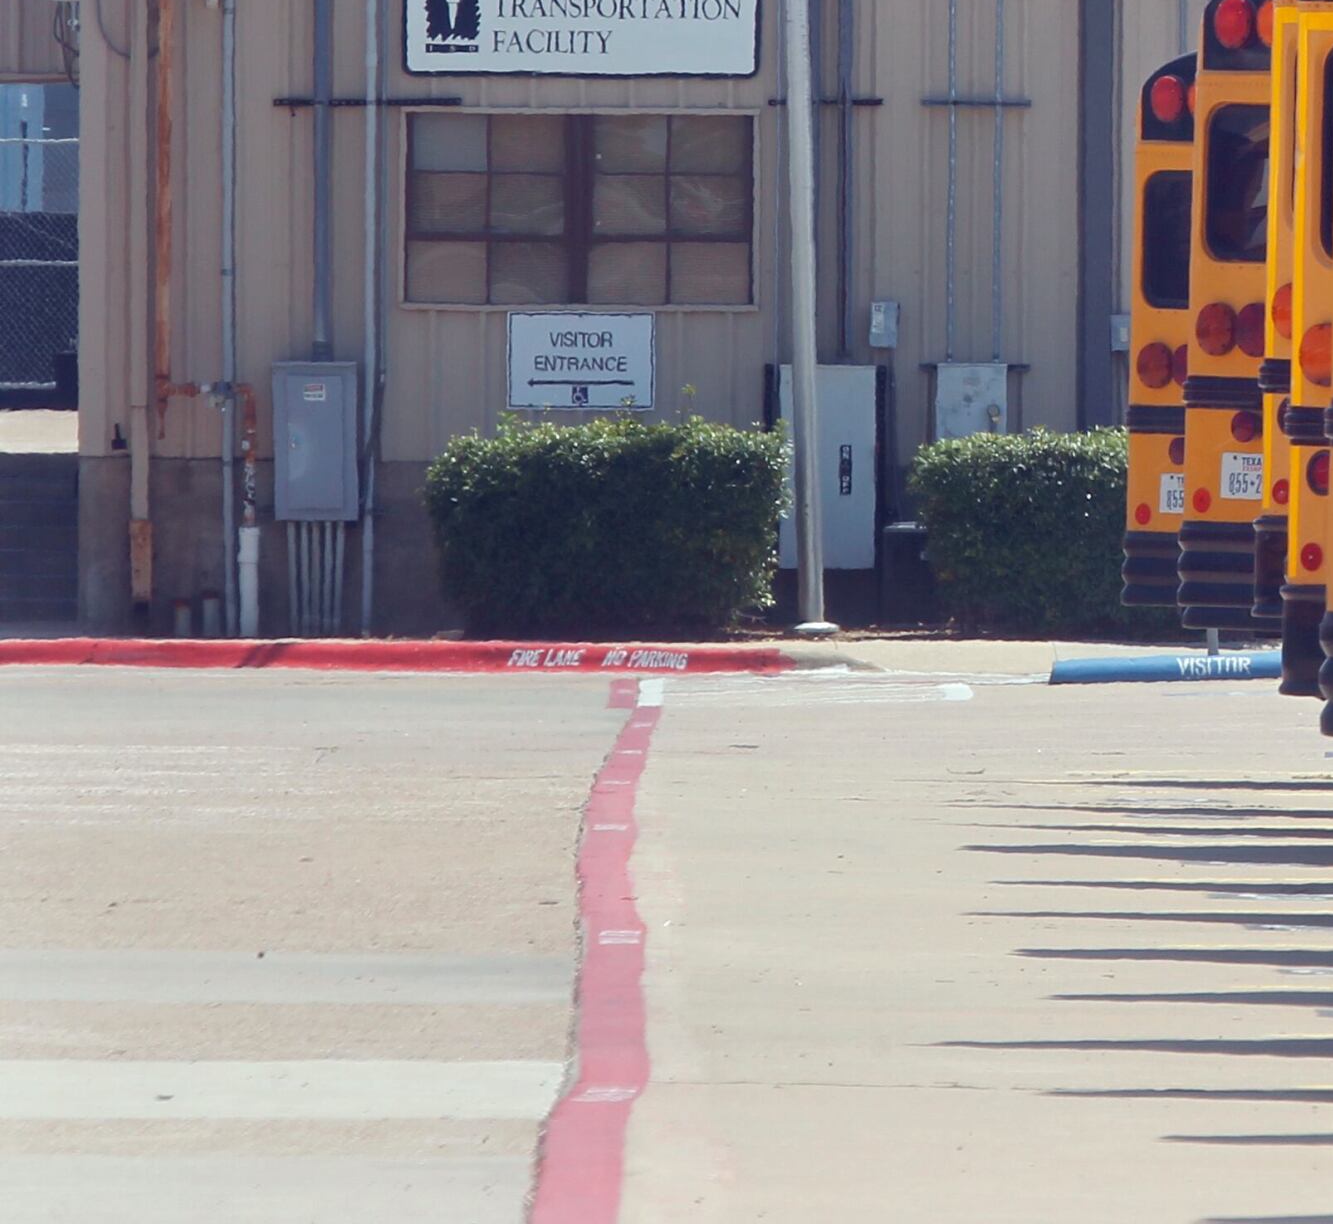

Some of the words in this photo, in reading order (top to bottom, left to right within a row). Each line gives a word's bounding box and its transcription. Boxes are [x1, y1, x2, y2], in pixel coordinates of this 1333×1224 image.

[492, 29, 613, 55] FACILITY
[549, 331, 613, 349] VISITOR
[534, 355, 628, 372] ENTRANCE
[1241, 456, 1263, 466] TEXA
[507, 649, 544, 667] FIRE
[544, 648, 586, 667] LANE
[602, 648, 628, 667] NO
[628, 649, 689, 670] PARKING
[1176, 655, 1252, 677] VISITOR
